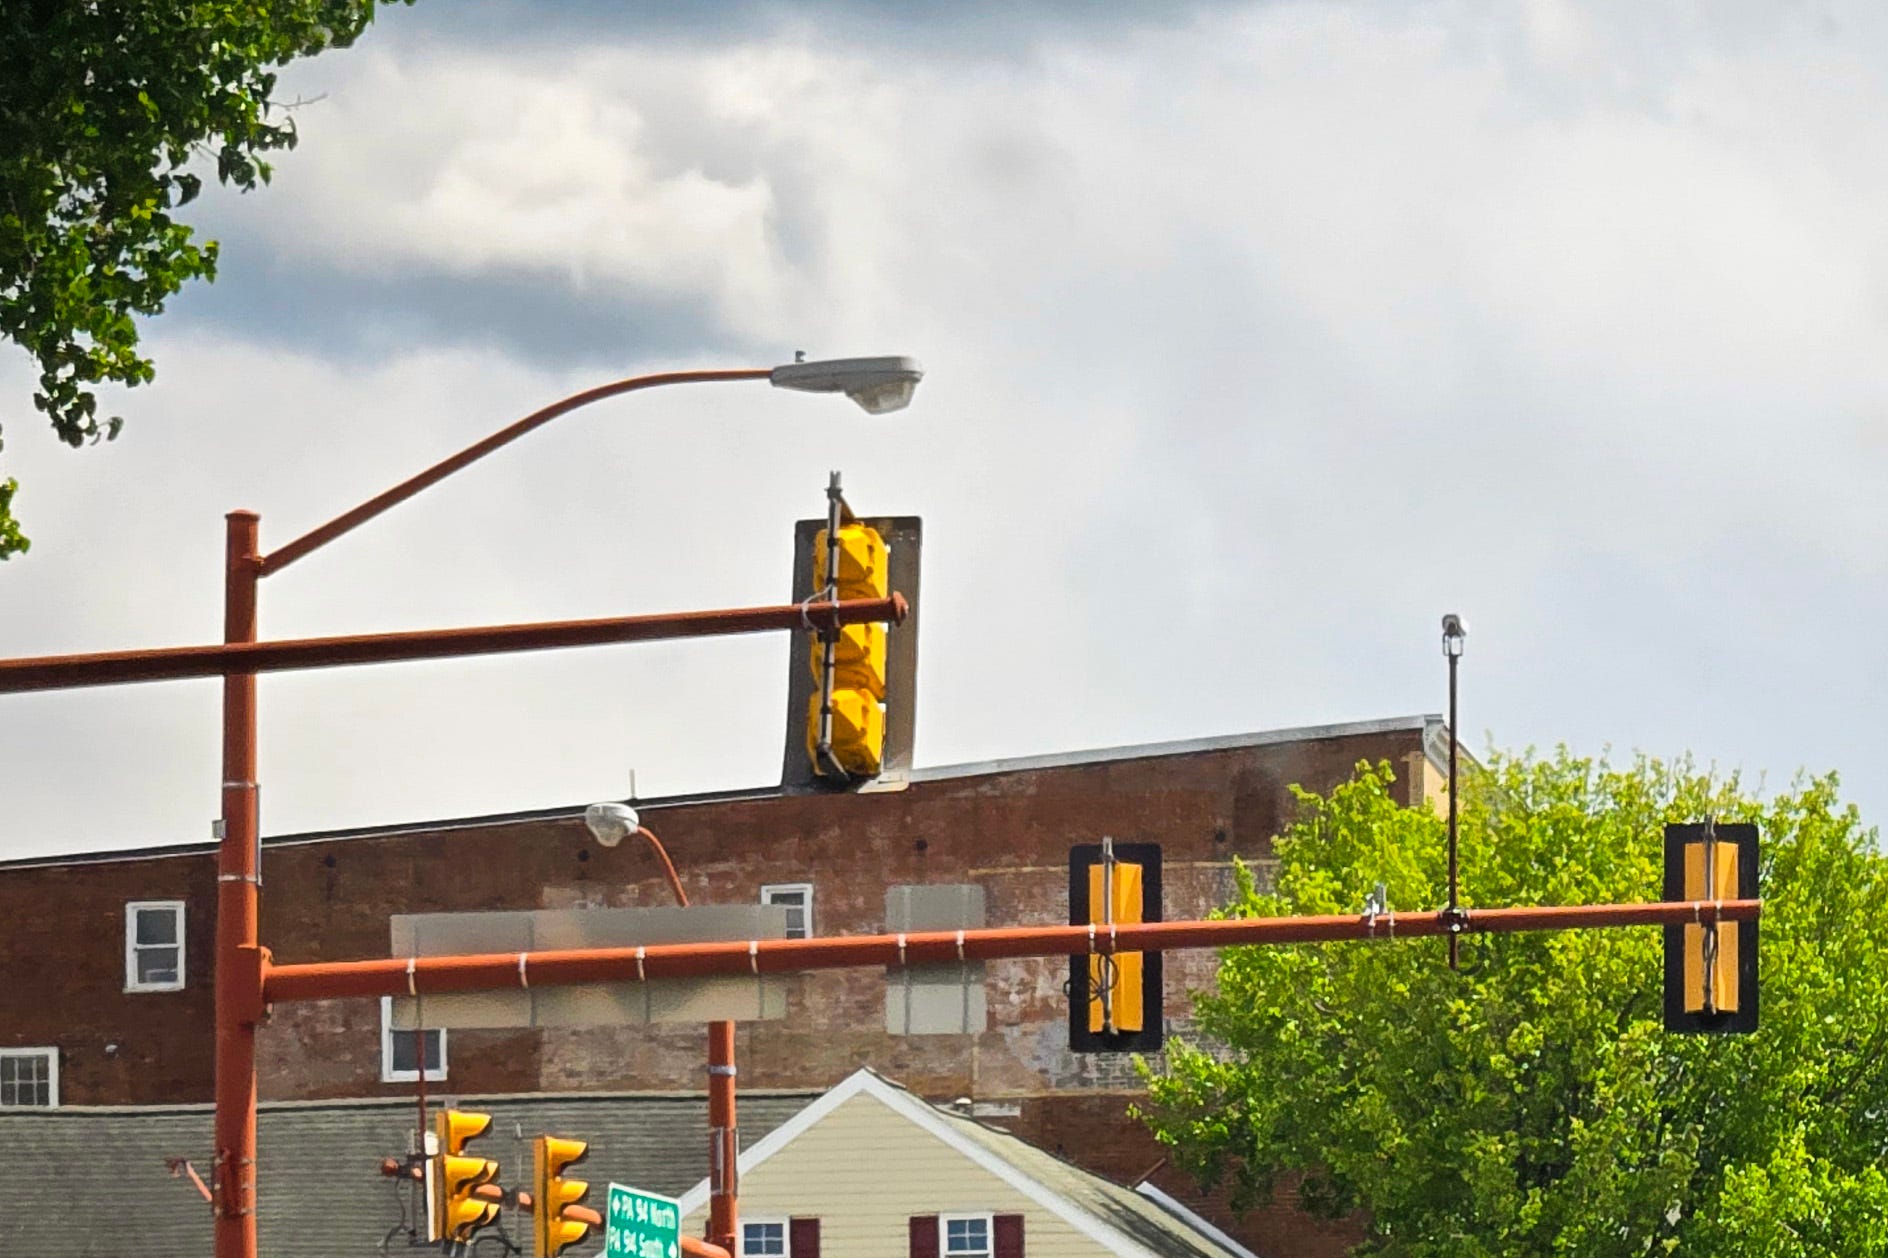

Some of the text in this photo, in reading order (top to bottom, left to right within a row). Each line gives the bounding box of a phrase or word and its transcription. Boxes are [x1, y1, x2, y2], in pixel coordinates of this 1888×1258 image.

[635, 1197, 649, 1224] 94
[650, 1201, 677, 1230] North
[623, 1228, 637, 1255] 94
